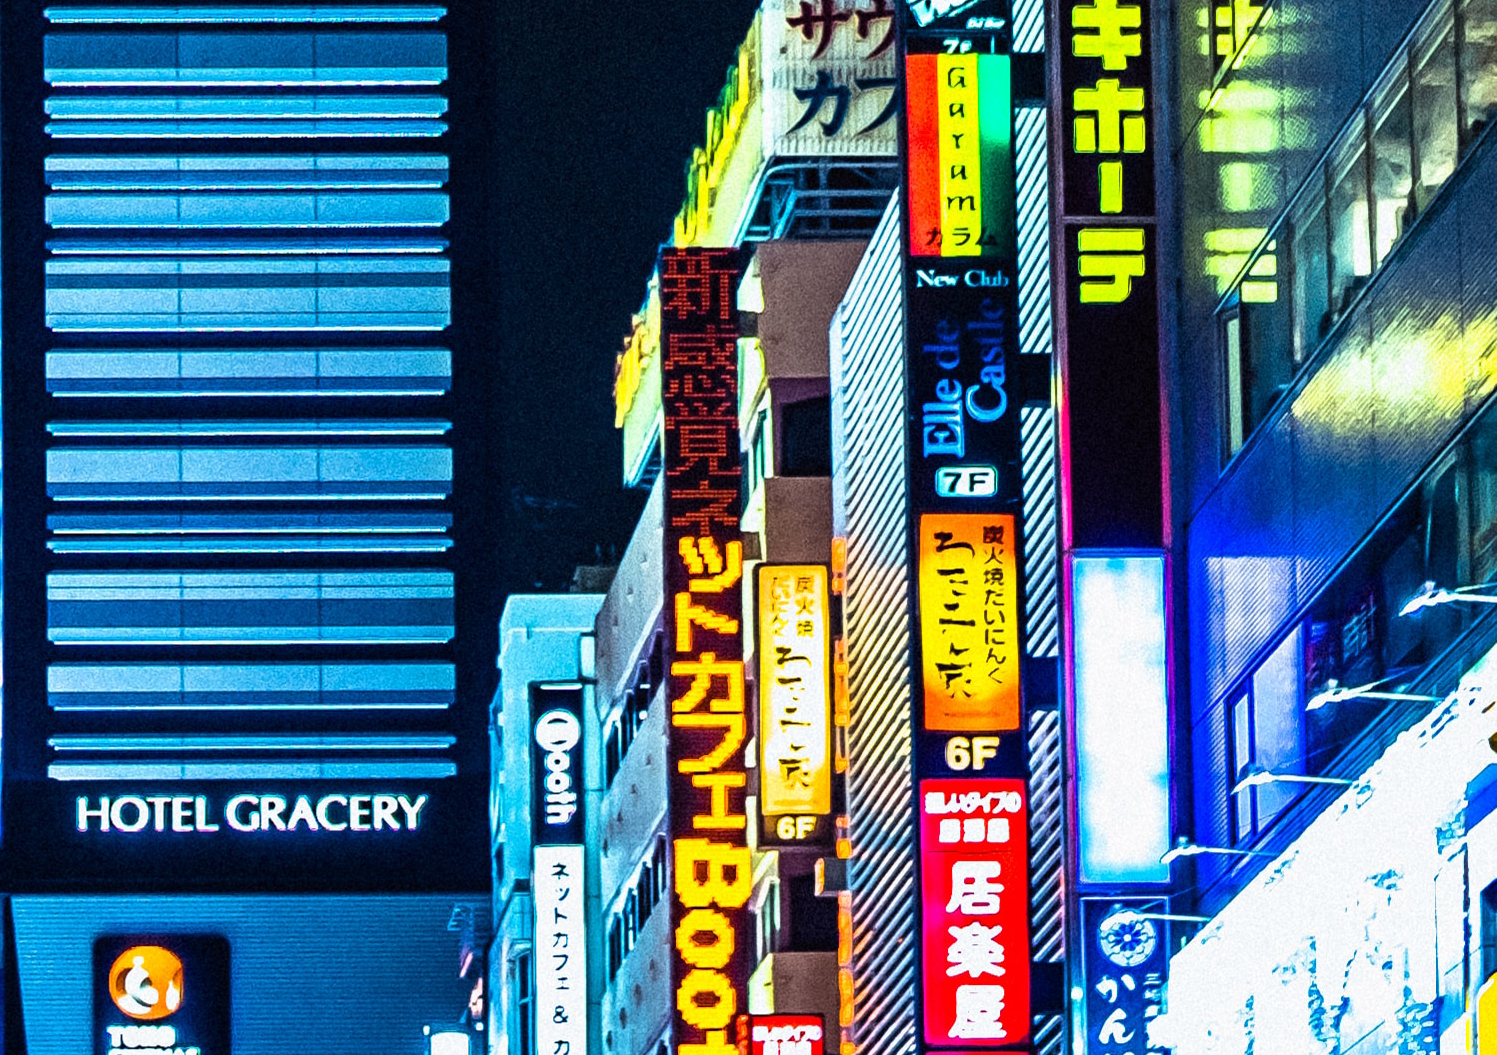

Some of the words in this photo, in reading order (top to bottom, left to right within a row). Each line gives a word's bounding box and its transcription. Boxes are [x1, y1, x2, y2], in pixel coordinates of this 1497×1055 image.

[1072, 0, 1145, 303] キホーテ
[916, 269, 959, 288] New
[964, 269, 1009, 287] Club
[937, 318, 960, 368] de
[965, 297, 1007, 421] Castle
[923, 377, 964, 459] Elle
[944, 471, 992, 494] 7F
[945, 737, 1000, 771] 6F
[76, 795, 218, 832] HOTEL
[226, 794, 427, 831] GRACERY
[777, 815, 817, 839] 6F
[551, 863, 570, 992] ネットカフェ
[946, 861, 1007, 1040] 居楽屋
[553, 1007, 568, 1025] &
